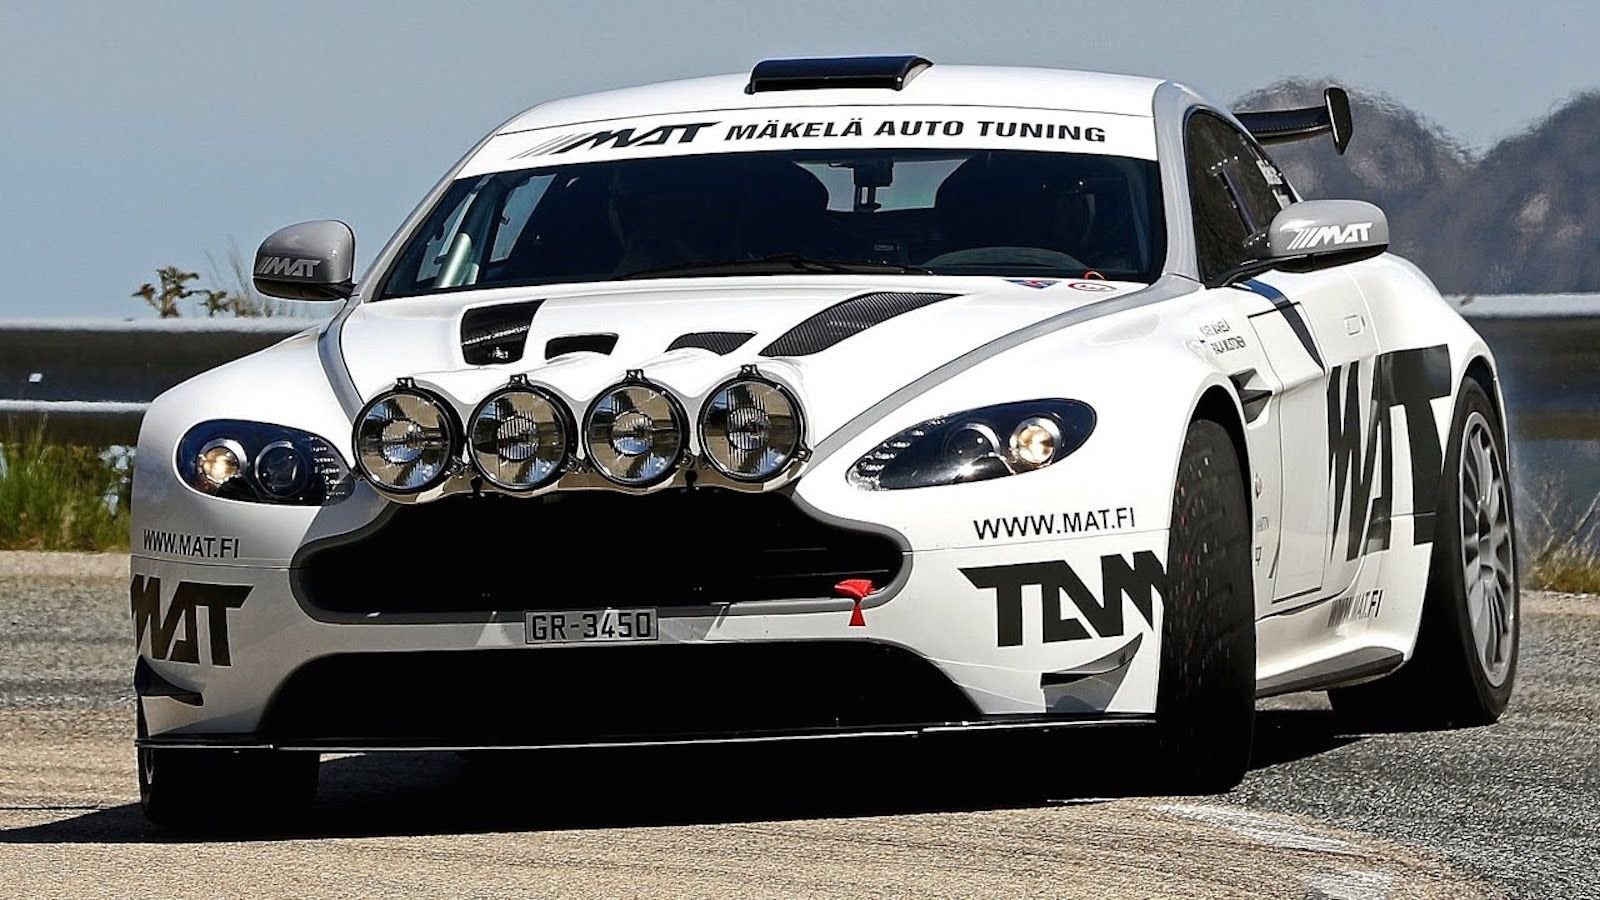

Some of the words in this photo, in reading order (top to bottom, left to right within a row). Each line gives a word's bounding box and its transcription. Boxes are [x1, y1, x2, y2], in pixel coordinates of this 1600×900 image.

[724, 118, 863, 141] MÄKELÄ
[873, 120, 964, 136] AUTO
[977, 120, 1106, 142] TUNING
[973, 507, 1136, 541] WWW.MAT.FI
[143, 529, 240, 559] WWW.MAT.FI
[130, 573, 255, 667] MAT
[532, 612, 651, 640] GR-3450
